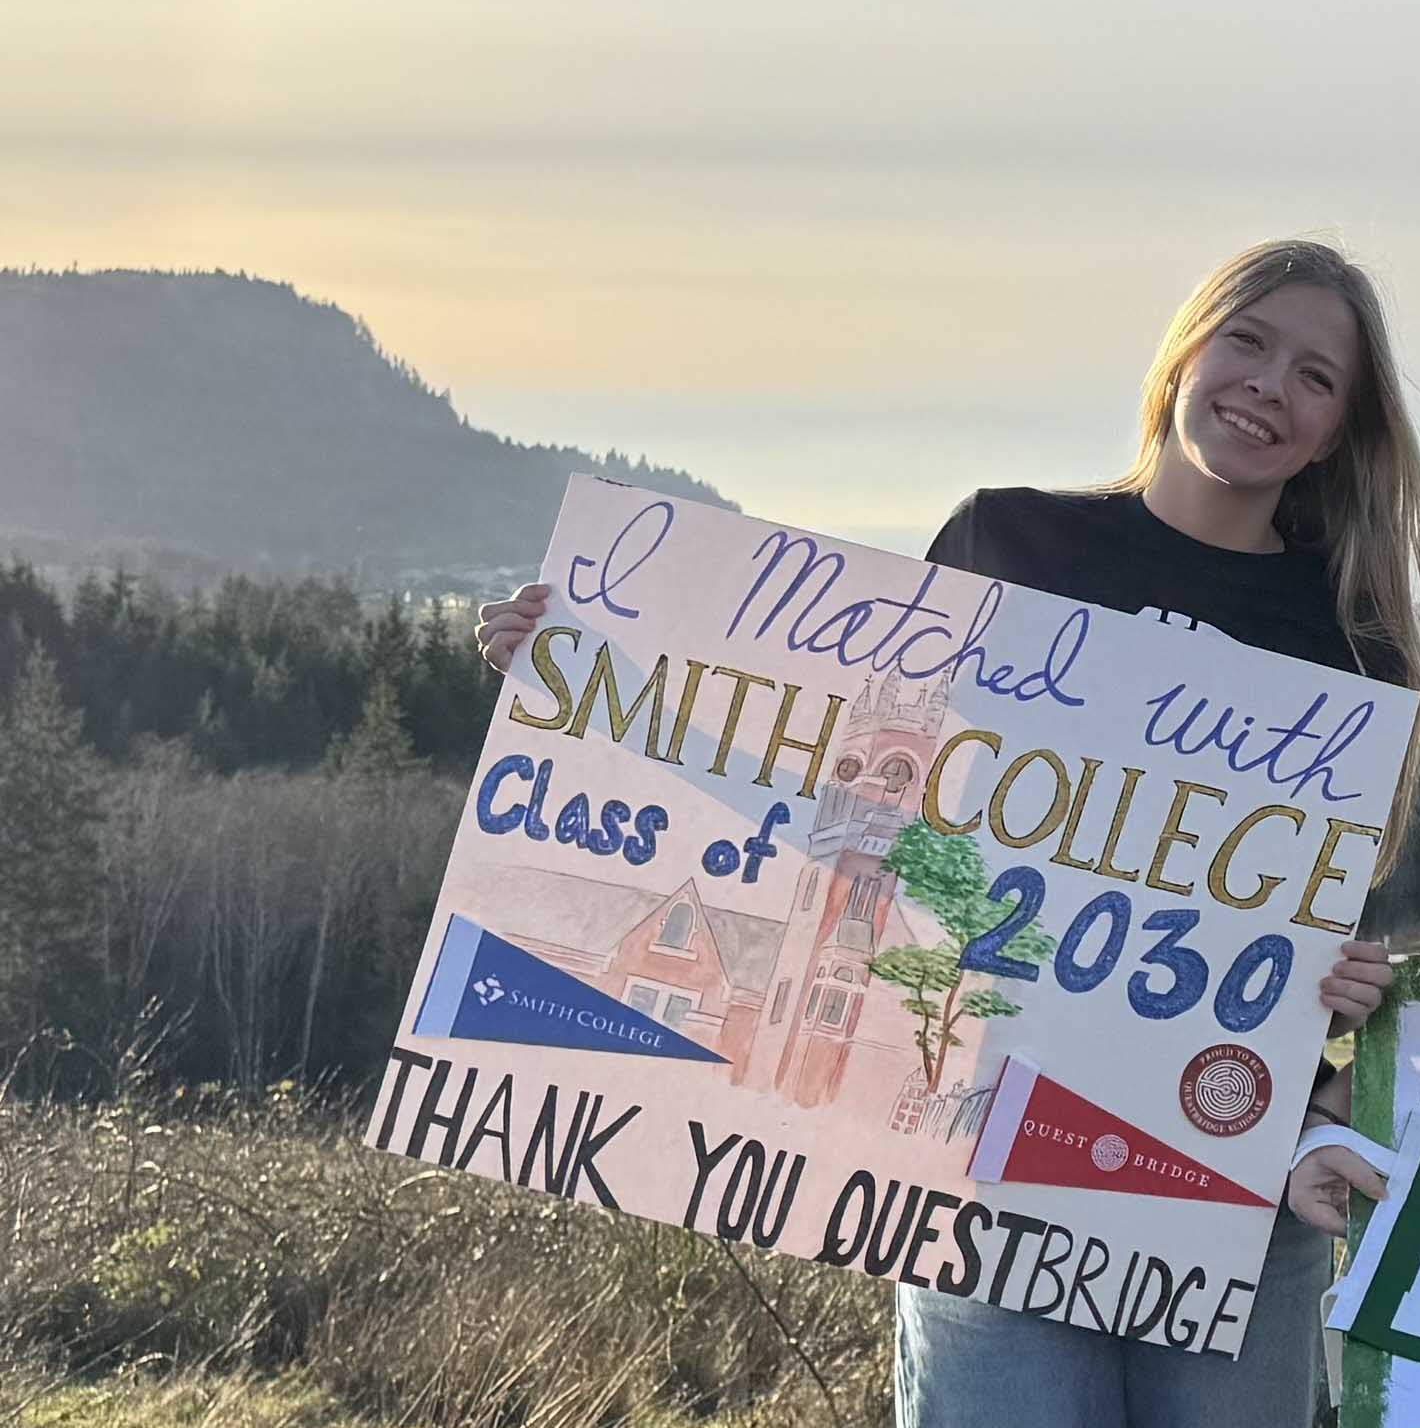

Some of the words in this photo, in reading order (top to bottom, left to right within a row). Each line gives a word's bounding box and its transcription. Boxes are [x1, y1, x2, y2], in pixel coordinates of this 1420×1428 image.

[508, 626, 848, 801] SMITH
[922, 728, 1385, 938] COLLEGE
[568, 501, 675, 619] I
[726, 530, 1086, 708] Matched
[1145, 682, 1375, 804] with
[476, 754, 669, 866] Class
[701, 801, 791, 884] of
[957, 865, 1295, 1034] 2030
[508, 989, 575, 1021] SMITH
[577, 1010, 665, 1049] COLLEGE
[374, 1046, 644, 1212] THANK
[682, 1120, 807, 1251] YOU
[819, 1169, 1258, 1362] QUESTBRIDGE
[1024, 1119, 1088, 1149] QUEST
[1133, 1153, 1211, 1187] BRIDGE
